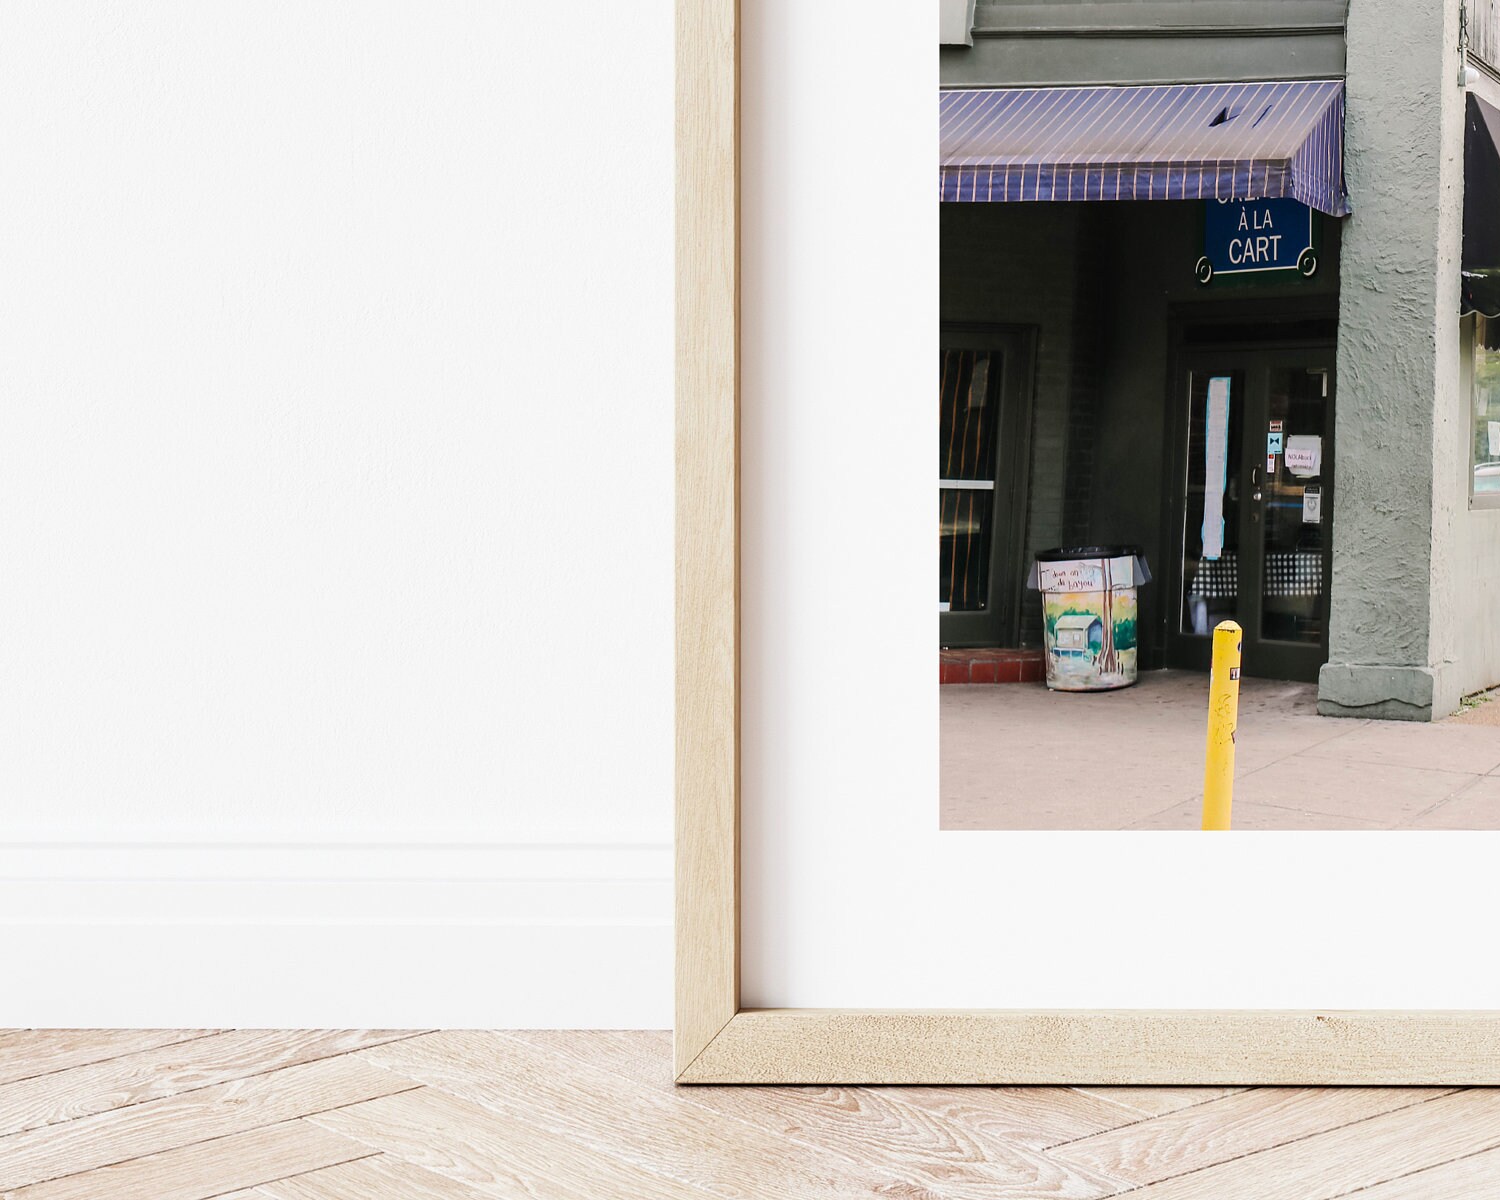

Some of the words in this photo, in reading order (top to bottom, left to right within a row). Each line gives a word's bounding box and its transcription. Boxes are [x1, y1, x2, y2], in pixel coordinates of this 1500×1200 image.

[1238, 205, 1249, 231] À
[1253, 208, 1273, 230] LA
[1228, 234, 1282, 264] CART
